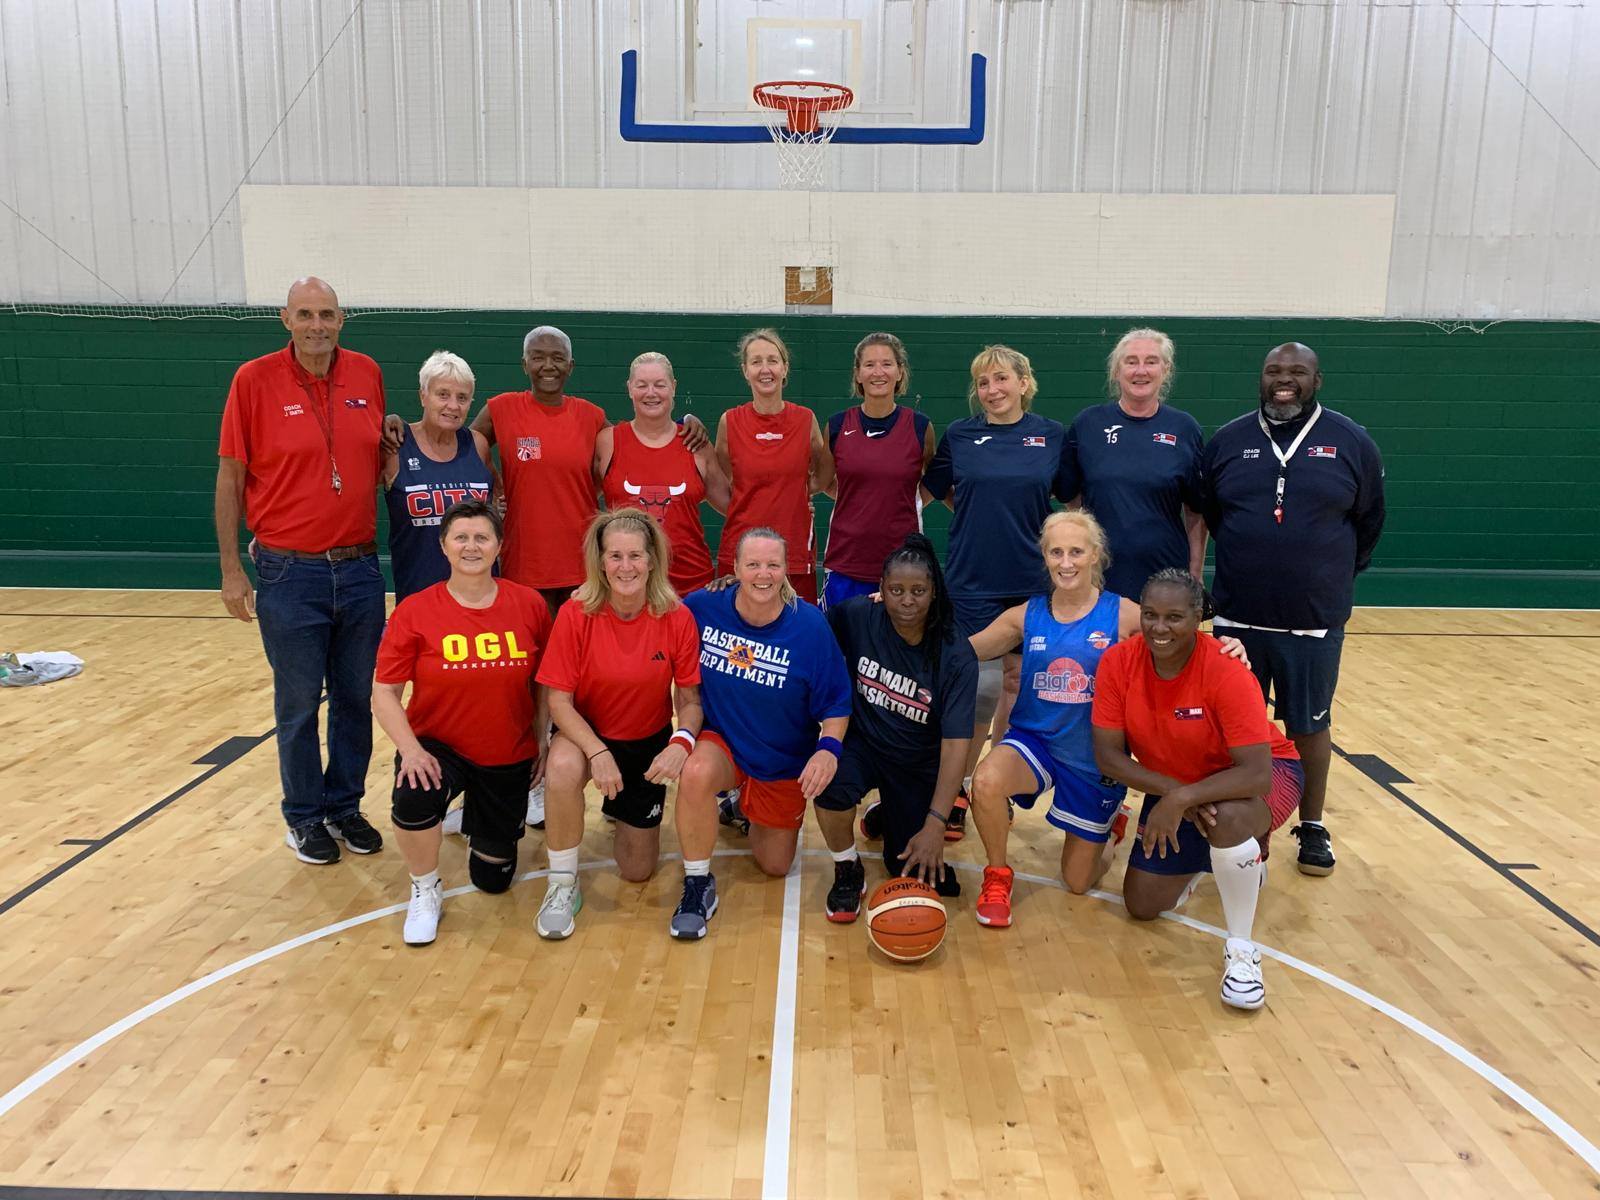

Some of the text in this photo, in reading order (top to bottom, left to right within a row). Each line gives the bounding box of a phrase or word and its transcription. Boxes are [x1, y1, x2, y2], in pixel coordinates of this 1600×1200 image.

[1106, 433, 1118, 443] 15
[406, 488, 489, 517] CITY
[442, 630, 528, 662] OGL
[701, 625, 790, 666] BASKETBALL
[442, 660, 528, 669] BASKETBALL
[699, 649, 786, 688] DEPARTMENT
[857, 656, 918, 698] GB MAXI
[856, 679, 929, 725] BASKETBALL
[883, 881, 930, 895] molten
